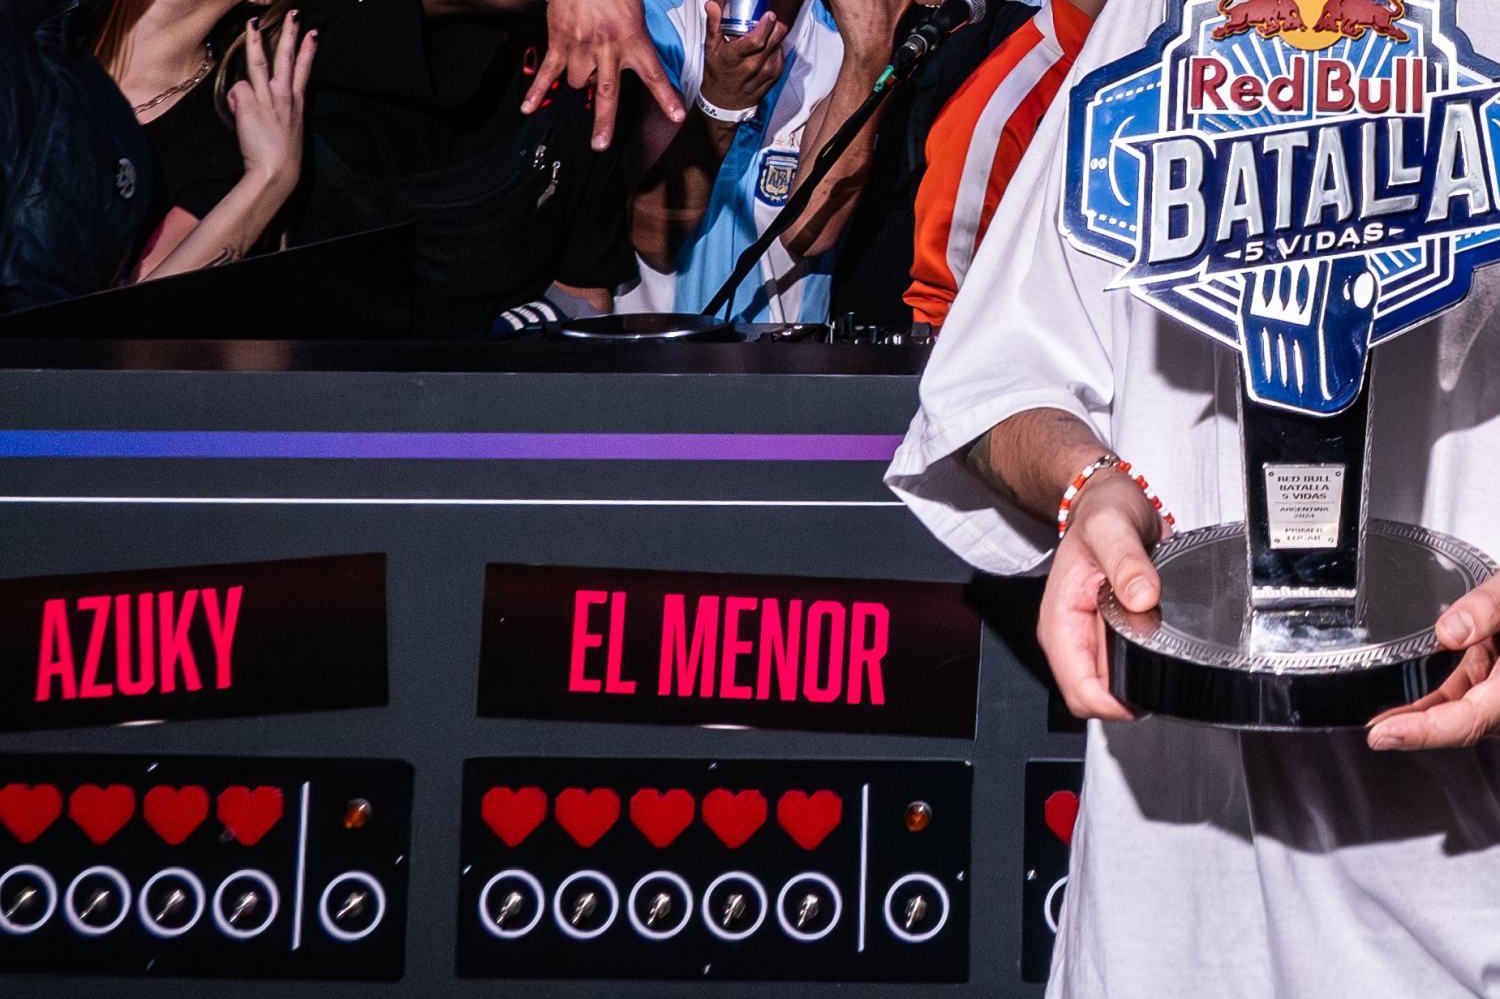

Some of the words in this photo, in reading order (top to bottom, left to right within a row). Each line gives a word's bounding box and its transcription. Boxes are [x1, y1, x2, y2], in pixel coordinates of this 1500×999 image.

[1190, 56, 1305, 112] Red
[1316, 57, 1425, 114] Bull
[1148, 100, 1491, 263] BATALLA
[1244, 240, 1265, 262] 5
[1276, 222, 1384, 260] VIDAS
[1277, 475, 1300, 483] RED
[1303, 475, 1332, 483] BULL
[1279, 484, 1330, 492] BATALLA
[36, 586, 244, 702] AZUKY
[568, 590, 637, 694] EL
[658, 594, 890, 706] MENOR
